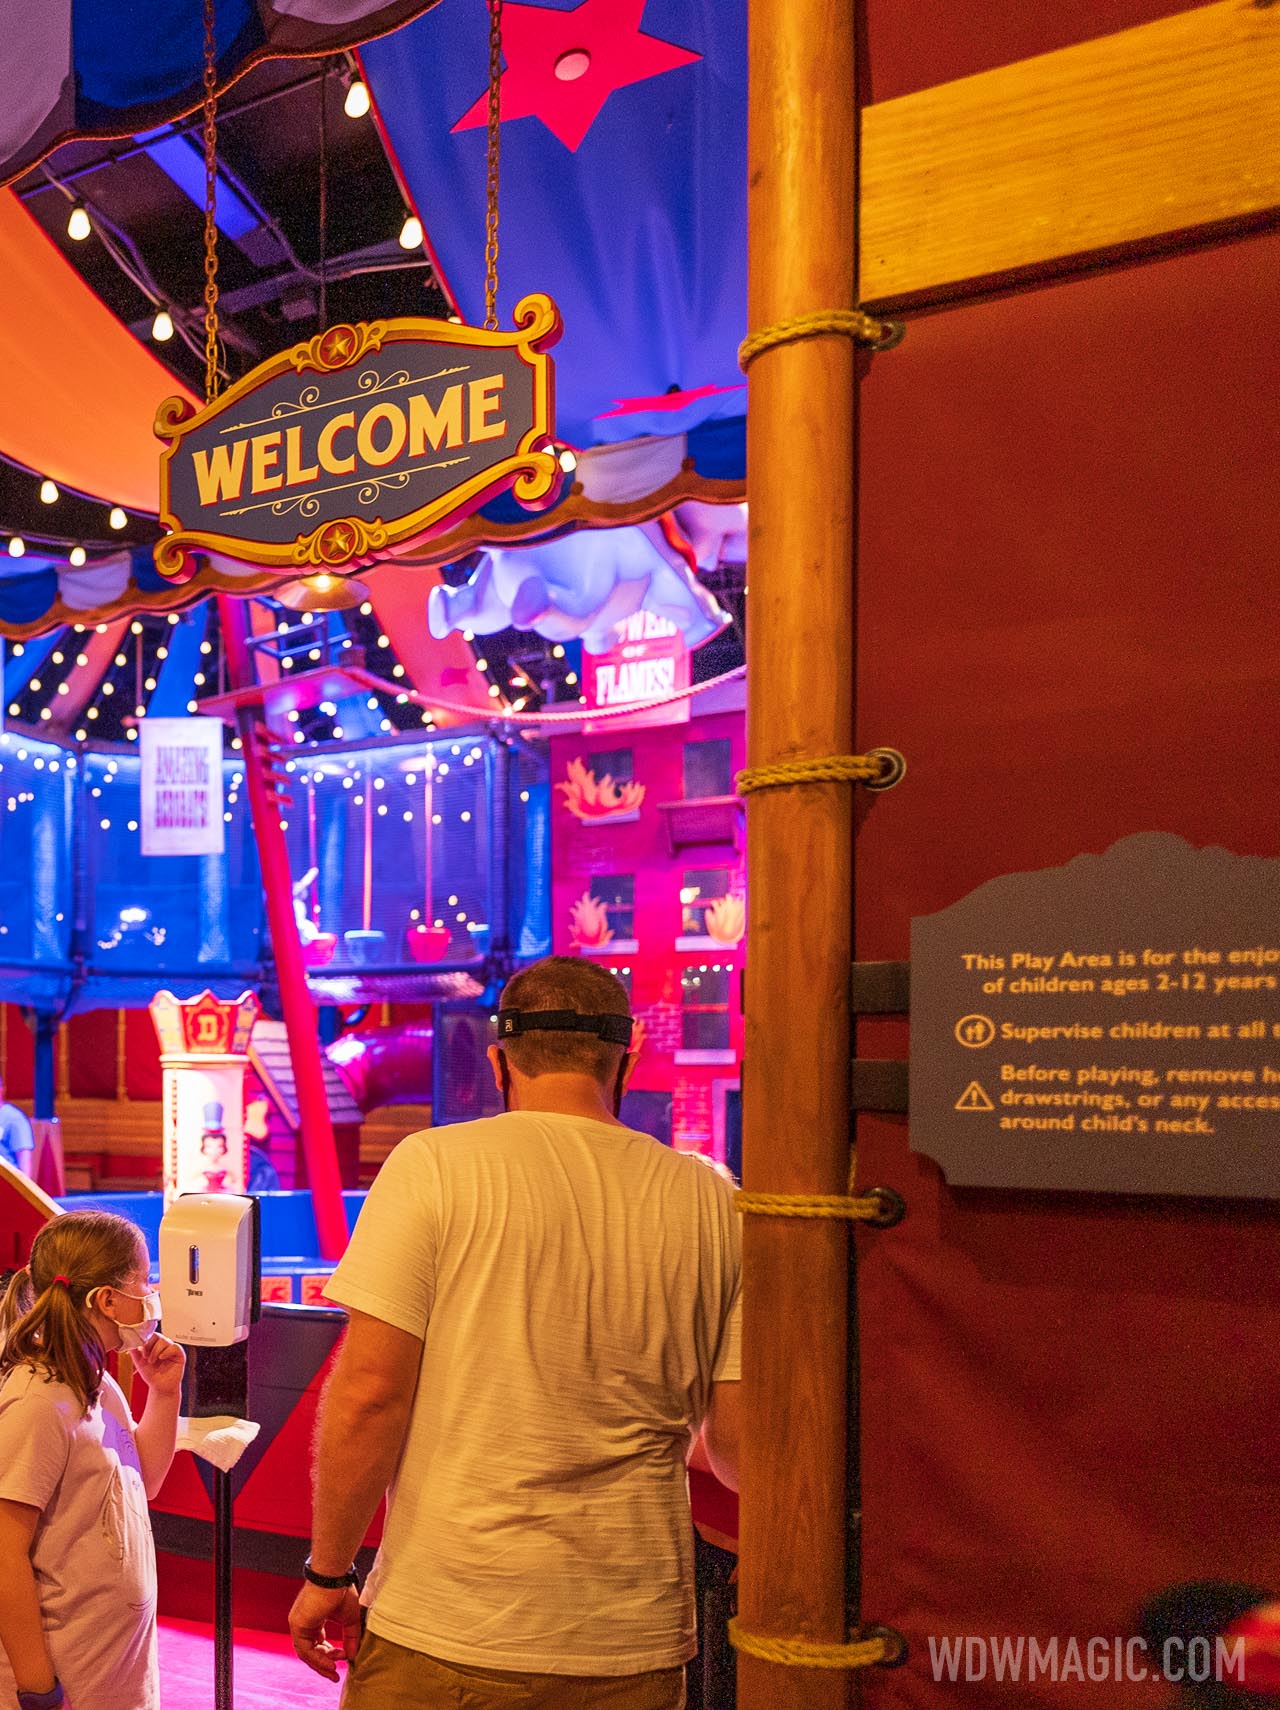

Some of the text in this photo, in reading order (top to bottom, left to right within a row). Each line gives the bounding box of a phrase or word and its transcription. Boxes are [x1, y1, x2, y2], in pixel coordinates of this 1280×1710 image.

[192, 373, 507, 507] WELCOME
[961, 953, 1005, 970] This
[1011, 952, 1055, 973] Play
[1059, 951, 1113, 968] Area
[1118, 950, 1136, 967] is
[1142, 948, 1175, 966] for
[1183, 947, 1221, 965] the
[982, 972, 1277, 996] of children ages 2-12 years
[197, 1014, 218, 1041] D
[1001, 1022, 1103, 1043] Supervise
[1109, 1022, 1200, 1039] children
[1207, 1024, 1230, 1038] at
[1238, 1021, 1266, 1038] all
[1001, 1064, 1071, 1082] Before
[1167, 1070, 1255, 1083] remove
[1137, 1095, 1163, 1107] or
[1170, 1095, 1210, 1112] any
[1000, 1114, 1075, 1130] around
[1081, 1115, 1148, 1132] child's
